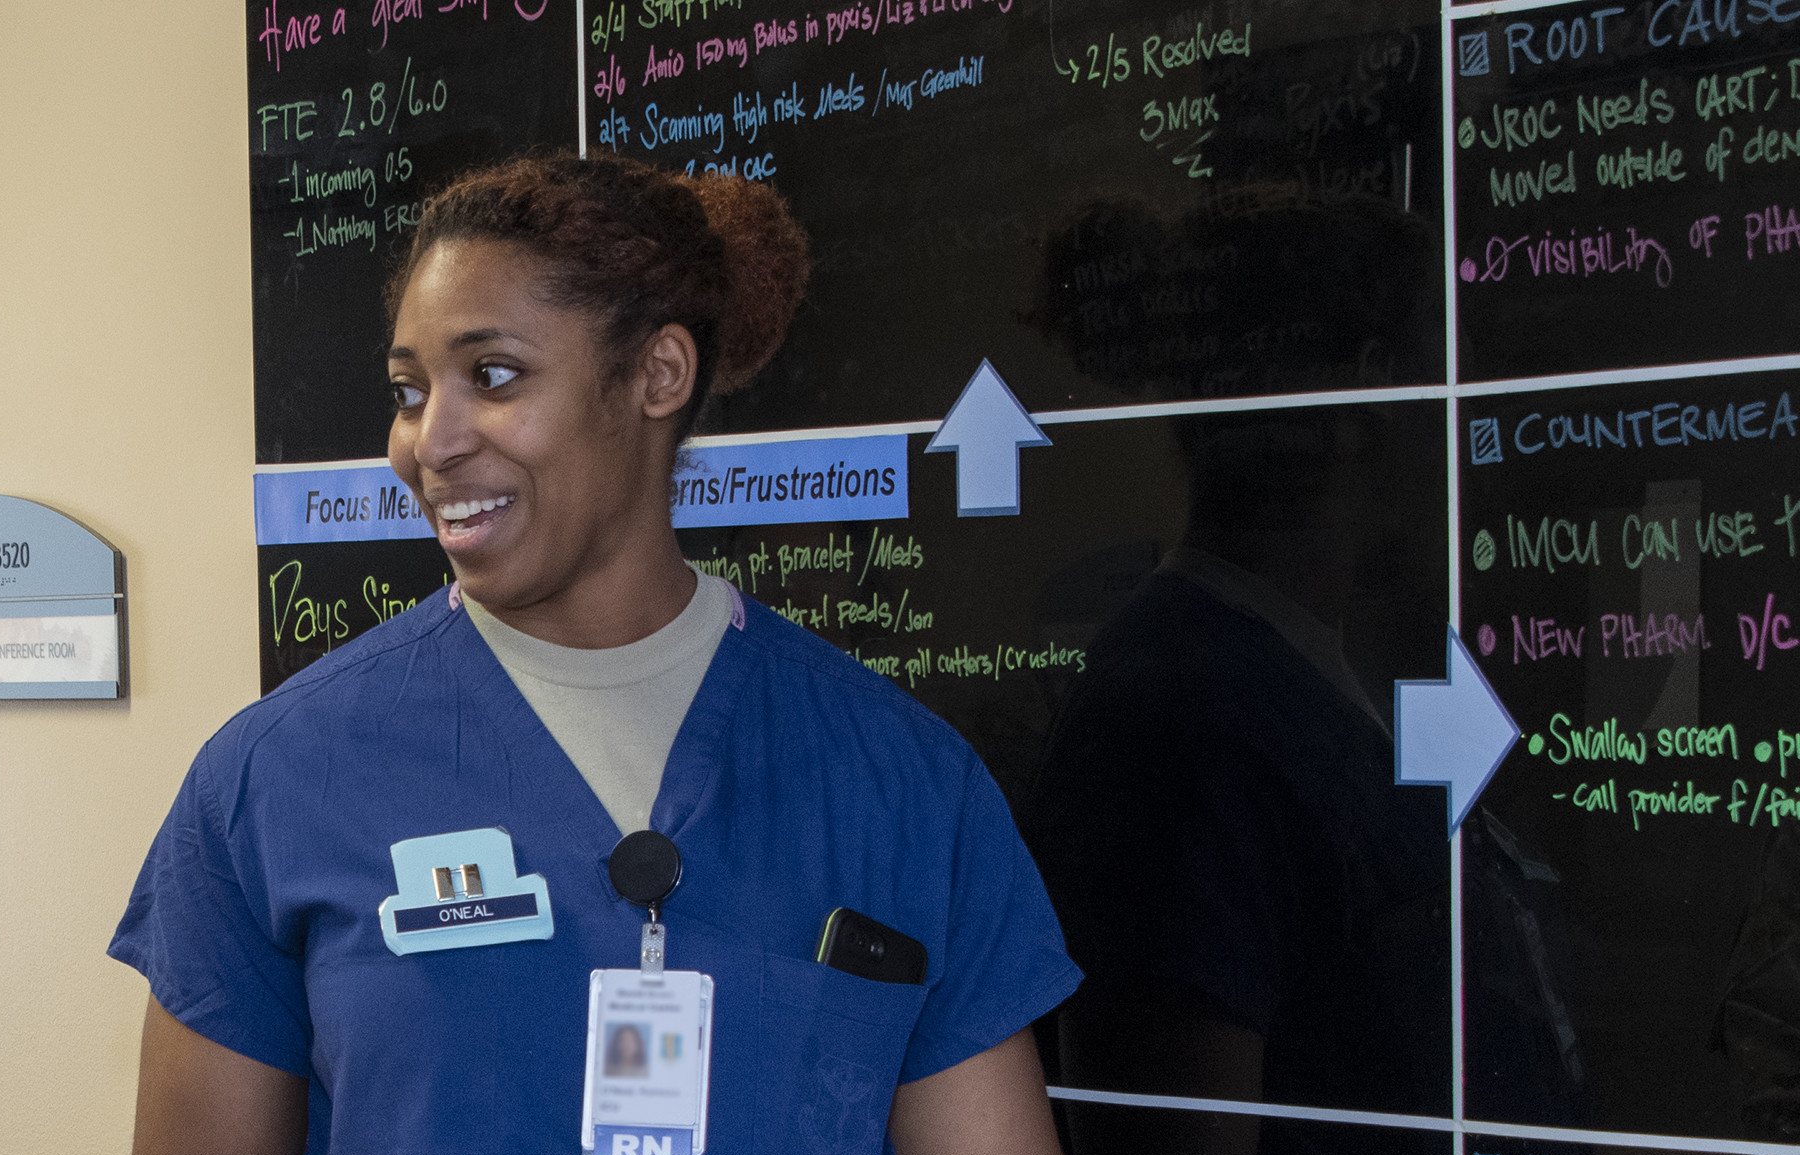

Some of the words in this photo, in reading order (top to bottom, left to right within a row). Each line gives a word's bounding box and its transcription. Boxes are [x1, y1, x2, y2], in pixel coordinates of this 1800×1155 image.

[258, 0, 322, 72] Have
[332, 9, 346, 36] a
[591, 2, 626, 52] 2/4
[1087, 33, 1130, 88] 2/5
[1143, 23, 1251, 78] Resolved
[1504, 7, 1625, 75] ROOT
[594, 54, 626, 104] 2/6
[805, 13, 819, 43] in
[257, 101, 318, 152] FTE
[599, 107, 630, 153] 2/7
[640, 102, 725, 154] Scanning
[732, 91, 768, 144] High
[773, 80, 806, 125] risk
[813, 72, 865, 120] Meds
[1481, 100, 1562, 152] JROC
[1577, 77, 1675, 137] Needs
[306, 160, 376, 208] incoming
[385, 147, 413, 182] 0.5
[743, 152, 777, 181] CAC
[1705, 126, 1735, 182] of
[1689, 215, 1721, 259] OF
[1514, 391, 1800, 455] COUNTERMEA
[305, 490, 371, 524] Focus
[748, 541, 773, 594] pt.
[777, 532, 854, 587] Bracelet
[1507, 513, 1601, 574] IMCU
[1696, 511, 1764, 557] USE
[269, 559, 350, 657] Days
[48, 642, 77, 659] ROOM
[1511, 614, 1585, 665] NEW
[1548, 713, 1646, 766] Swallow
[1657, 723, 1739, 760] screen
[1627, 780, 1721, 831] provider
[439, 904, 495, 922] O'NEAL
